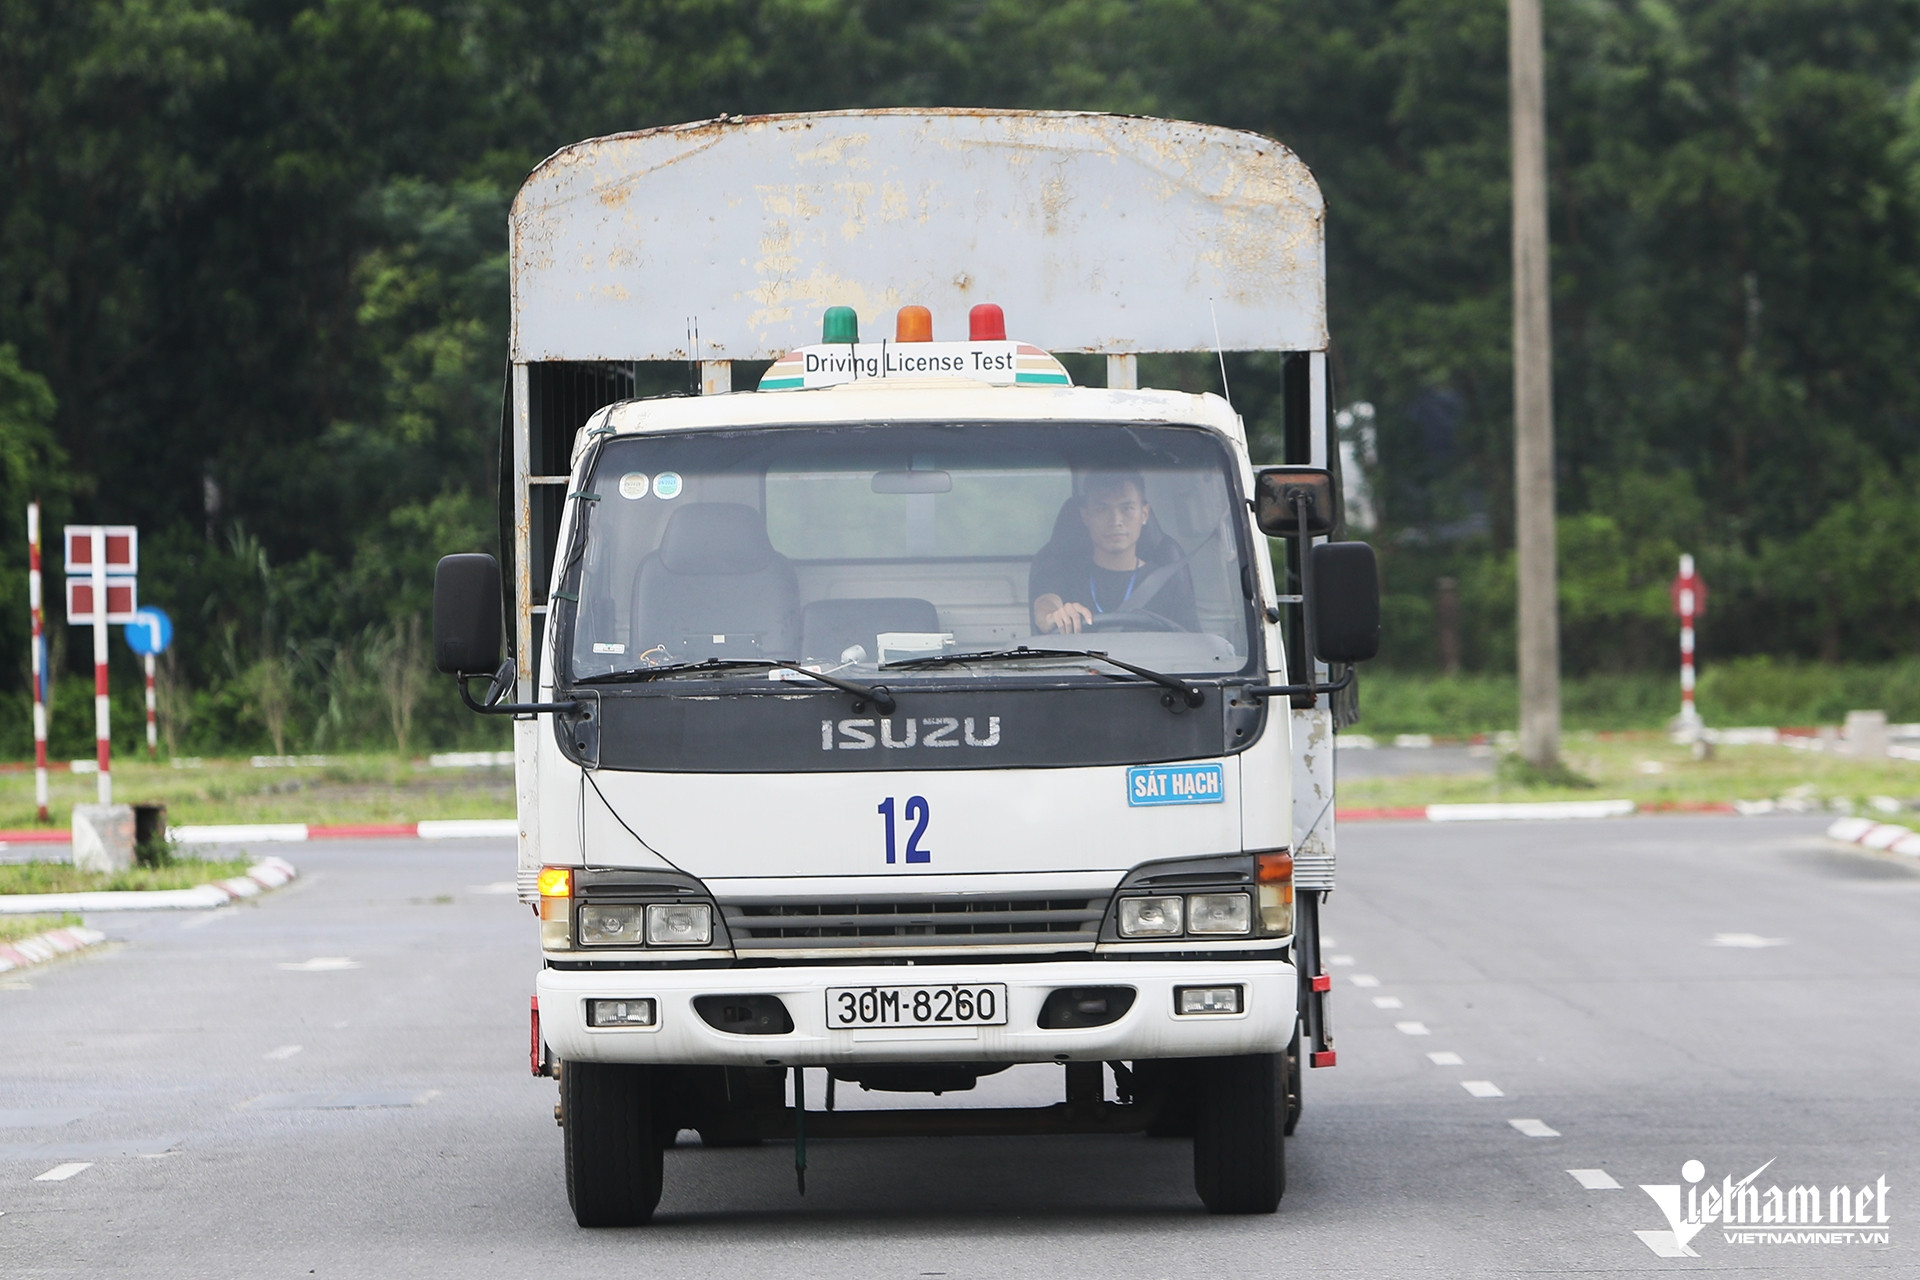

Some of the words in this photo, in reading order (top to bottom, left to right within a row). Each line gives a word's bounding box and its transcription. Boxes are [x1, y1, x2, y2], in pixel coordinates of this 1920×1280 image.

[806, 353, 878, 377] Driving
[886, 353, 964, 371] License
[970, 351, 1013, 370] Test
[821, 716, 1001, 750] ISUZU
[1134, 770, 1167, 798] SÁT
[1172, 772, 1219, 799] HẠCH
[877, 795, 931, 864] 12
[838, 988, 995, 1024] 30M-8260
